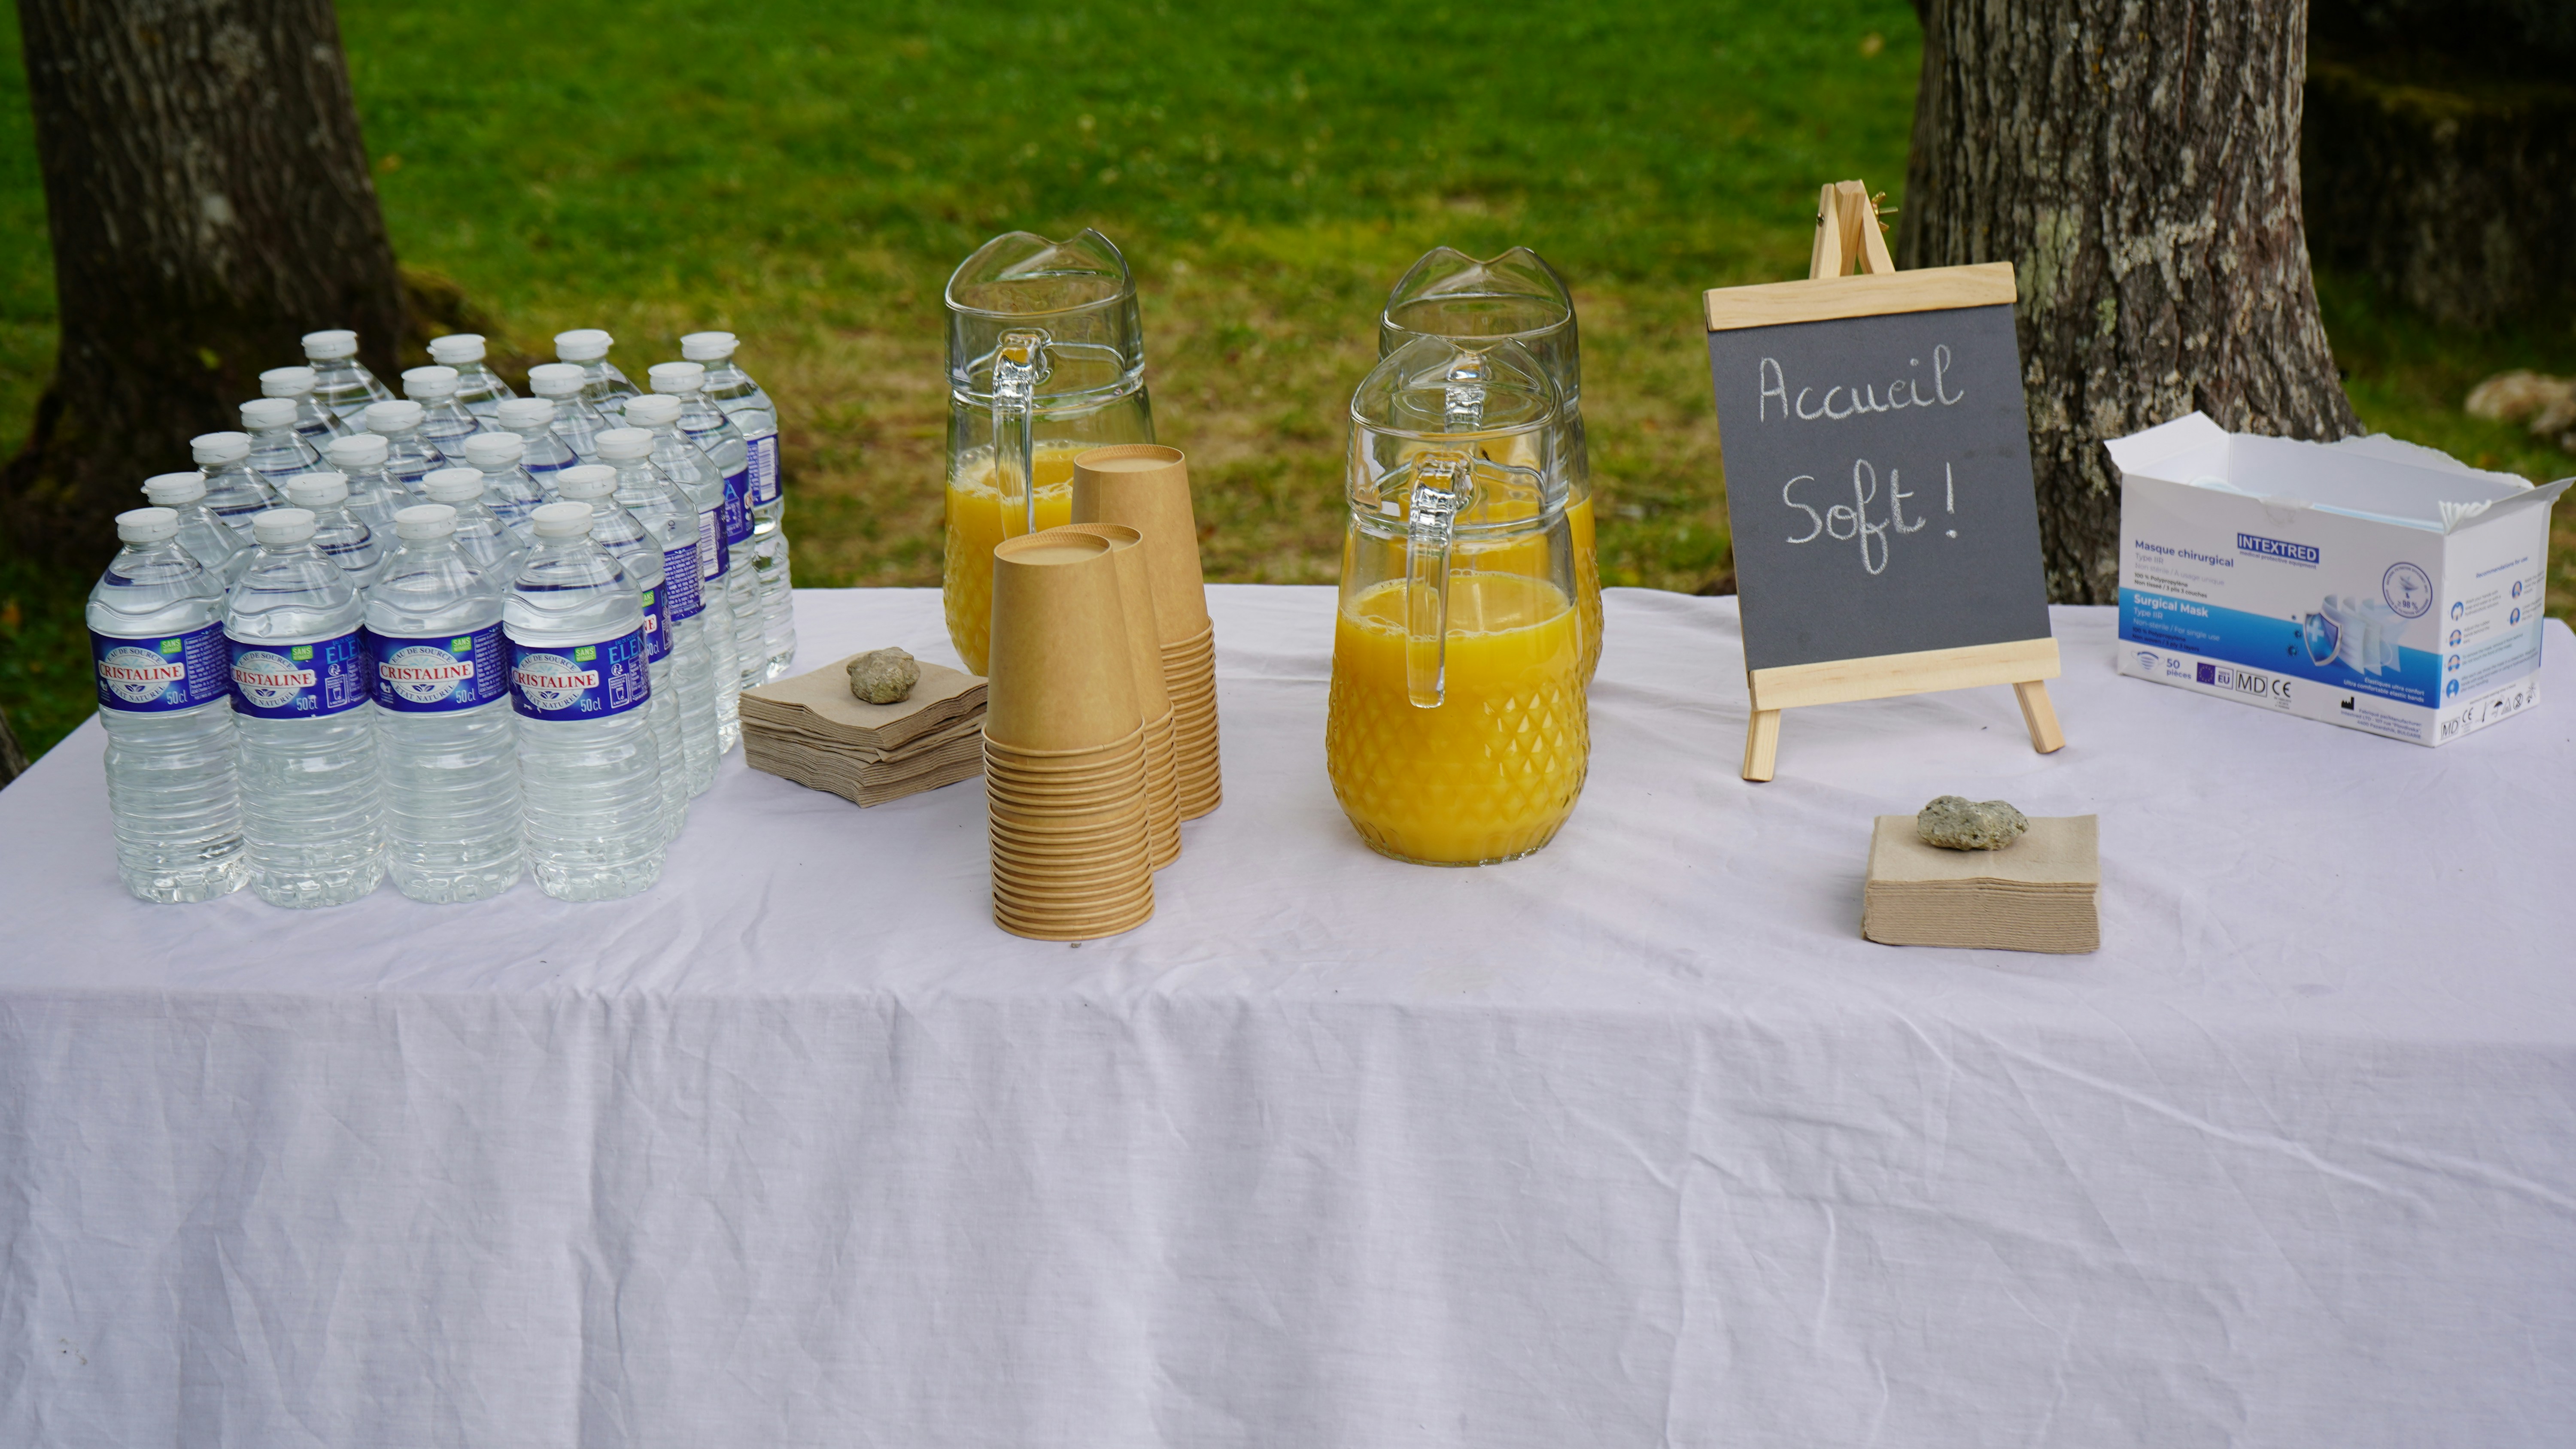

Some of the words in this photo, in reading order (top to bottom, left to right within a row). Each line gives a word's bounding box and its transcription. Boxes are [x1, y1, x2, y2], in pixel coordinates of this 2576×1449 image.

[1760, 344, 1964, 423] Accueil
[1783, 459, 1926, 575] Soft
[1945, 462, 1958, 540] !
[2136, 540, 2175, 555] Masque
[2178, 549, 2233, 568] chirurgical
[2239, 534, 2317, 561] INTEXTRED
[2136, 553, 2152, 563] Type
[2154, 557, 2164, 565] IIR
[2239, 551, 2260, 559] medical
[2261, 555, 2287, 564] protective
[2289, 560, 2316, 570] equipment
[2150, 564, 2169, 575] stérile
[2181, 572, 2200, 581] usage
[2202, 576, 2225, 586] unique
[2185, 590, 2207, 599] couches
[2134, 594, 2178, 612] Surgical
[2180, 603, 2208, 618] Mask
[2134, 607, 2151, 618] Type
[2153, 611, 2163, 620] IIR
[2133, 618, 2169, 631] Non-sterile
[2174, 626, 2185, 634] For
[2187, 629, 2207, 639] single
[162, 639, 180, 649] SANS
[453, 637, 470, 647] SANS
[2170, 641, 2179, 649] ply
[2184, 643, 2200, 652] layers
[107, 649, 118, 662] EAU
[129, 647, 162, 664] SOURCE
[292, 647, 311, 656] SANS
[392, 650, 405, 663] EAU
[419, 647, 453, 663] SOURCE
[576, 648, 594, 657] SANS
[239, 655, 250, 666] EAU
[261, 652, 293, 670] SOURCE
[521, 655, 533, 668] EAU
[544, 655, 577, 671] SOURCE
[2167, 658, 2180, 669] 50
[100, 664, 182, 680] CRISTALINE
[231, 667, 312, 687] CRISTALINE
[380, 664, 471, 680] CRISTALINE
[512, 670, 597, 688] CRISTALINE
[2166, 669, 2191, 680] pièces
[2218, 675, 2230, 685] EU
[2238, 673, 2266, 693] MD
[128, 685, 166, 702] NATUREL
[166, 689, 188, 705] 50cl
[258, 691, 295, 707] NATUREL
[416, 685, 455, 702] NATUREL
[456, 688, 476, 704] 50cl
[2357, 683, 2389, 695] comfortable
[2390, 691, 2407, 699] elastic
[2408, 694, 2424, 703] bands
[2405, 688, 2425, 696] confort
[296, 697, 319, 711] 50cl
[542, 693, 580, 709] NATUREL
[580, 697, 602, 712] 50cl
[2443, 720, 2458, 737] MD
